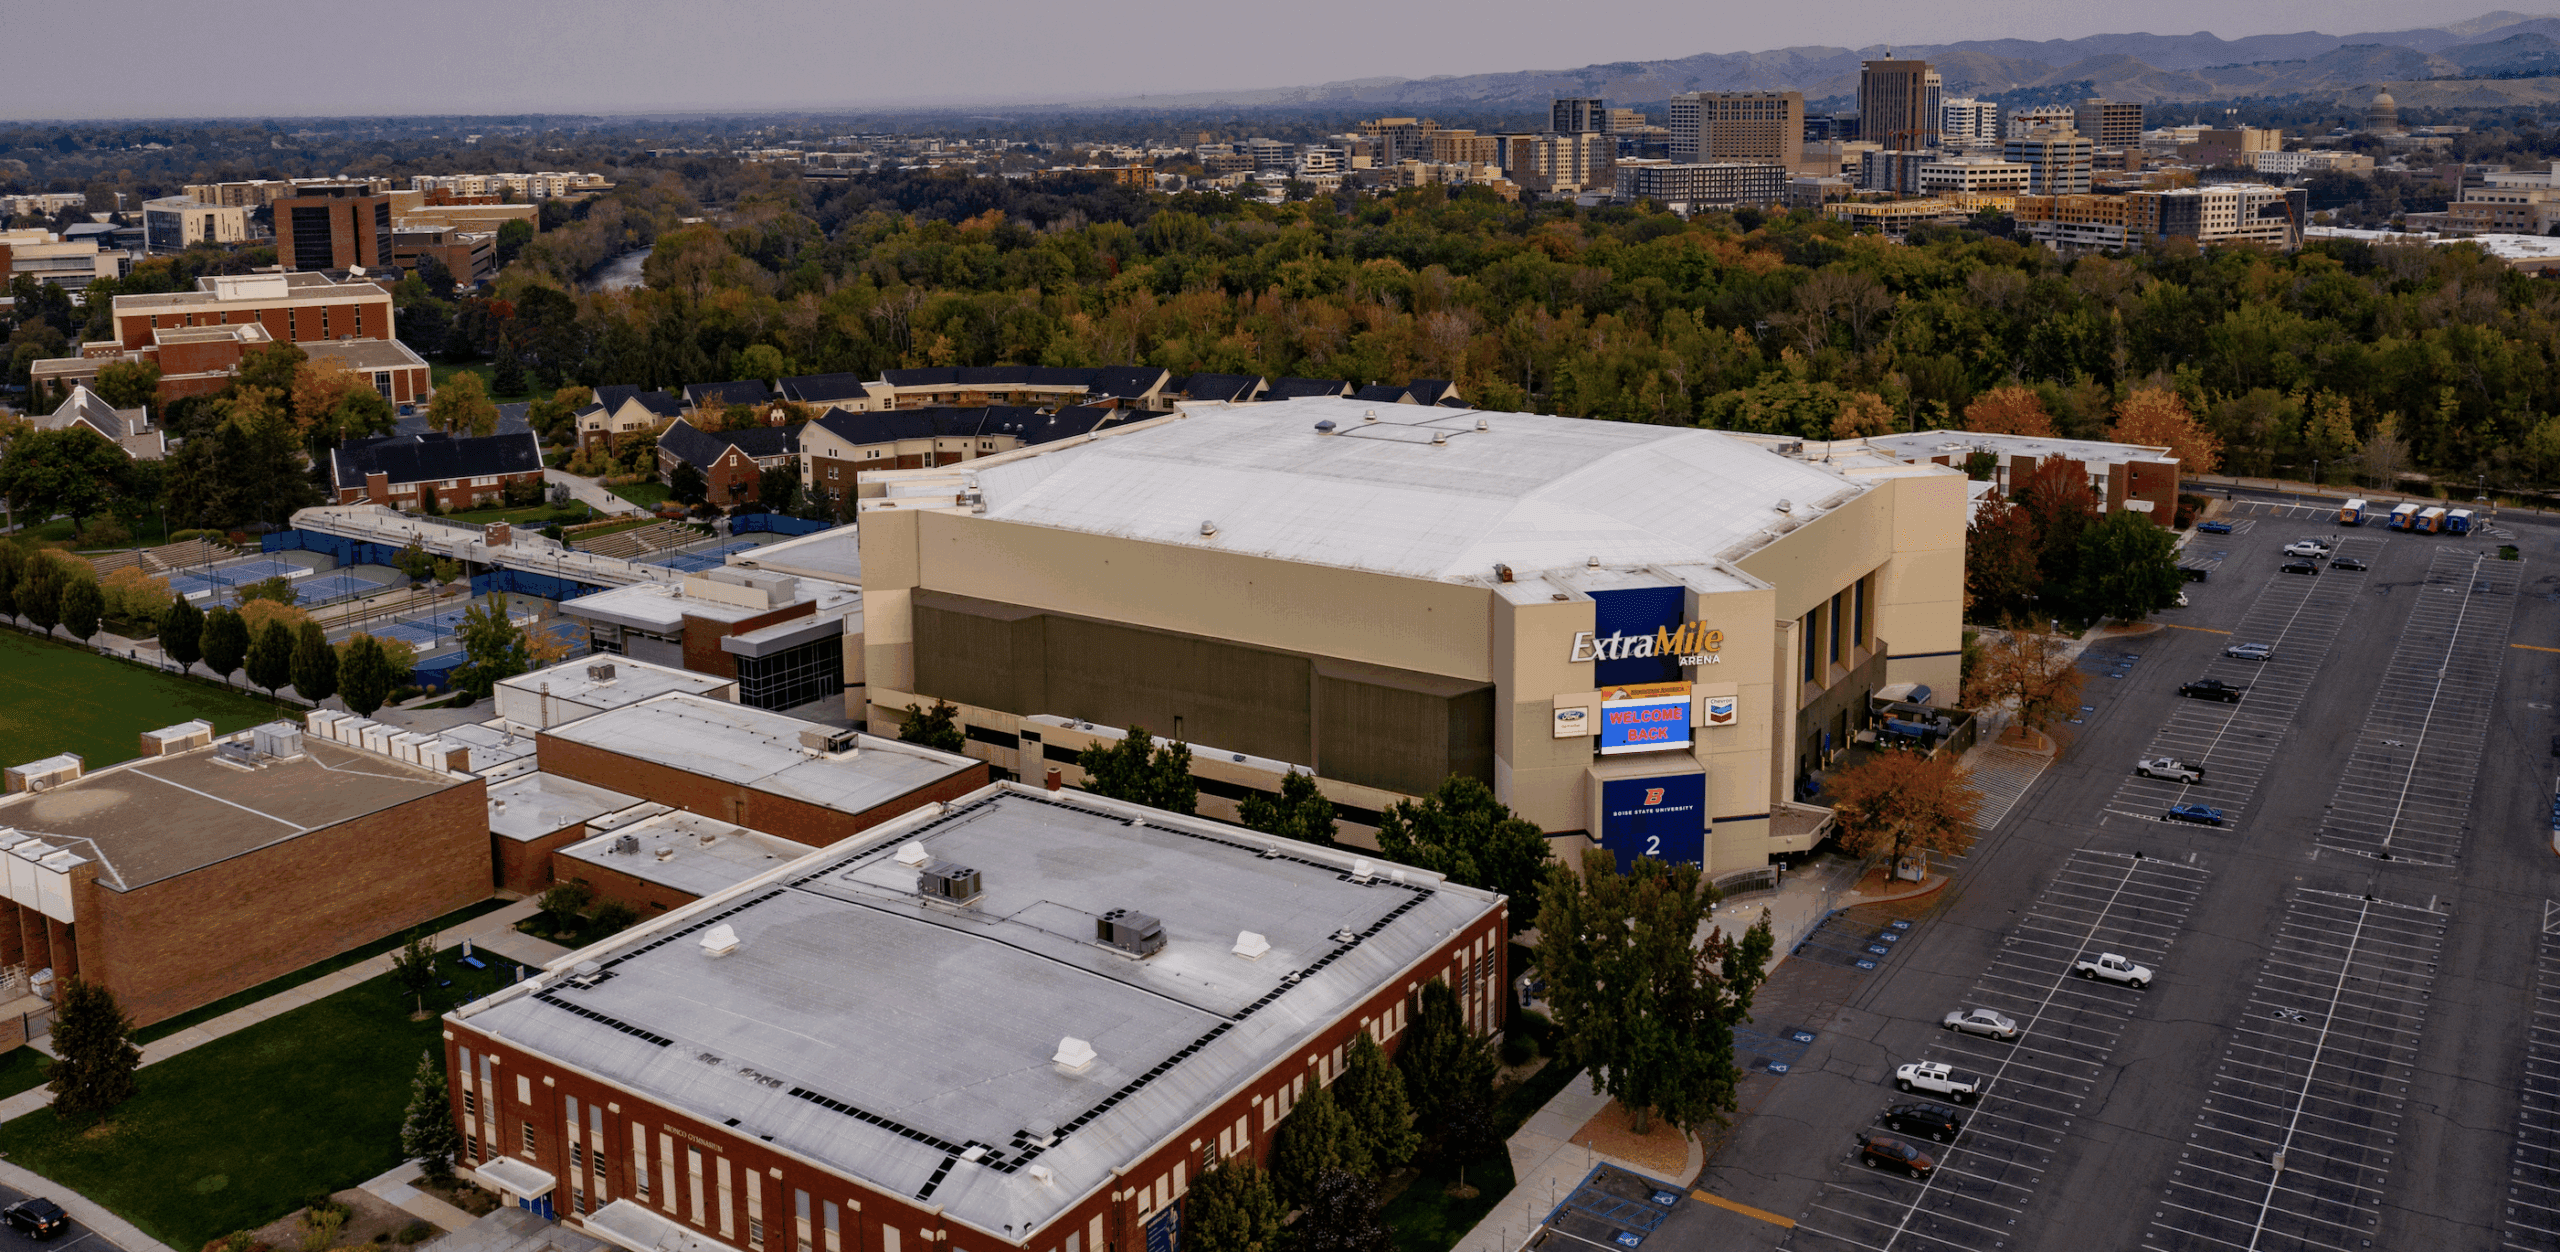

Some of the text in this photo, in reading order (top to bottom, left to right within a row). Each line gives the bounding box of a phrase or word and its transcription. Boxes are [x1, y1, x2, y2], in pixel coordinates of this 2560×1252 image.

[1570, 620, 1723, 662] ExtraMile
[1679, 655, 1720, 666] ARENA
[1609, 708, 1683, 725] WELCOME
[1628, 727, 1668, 741] BACK
[1644, 788, 1665, 805] B
[1655, 805, 1693, 813] UNIVERSITY
[1646, 835, 1660, 855] 2
[663, 1123, 723, 1153] BRONCO GYMNASIUM
